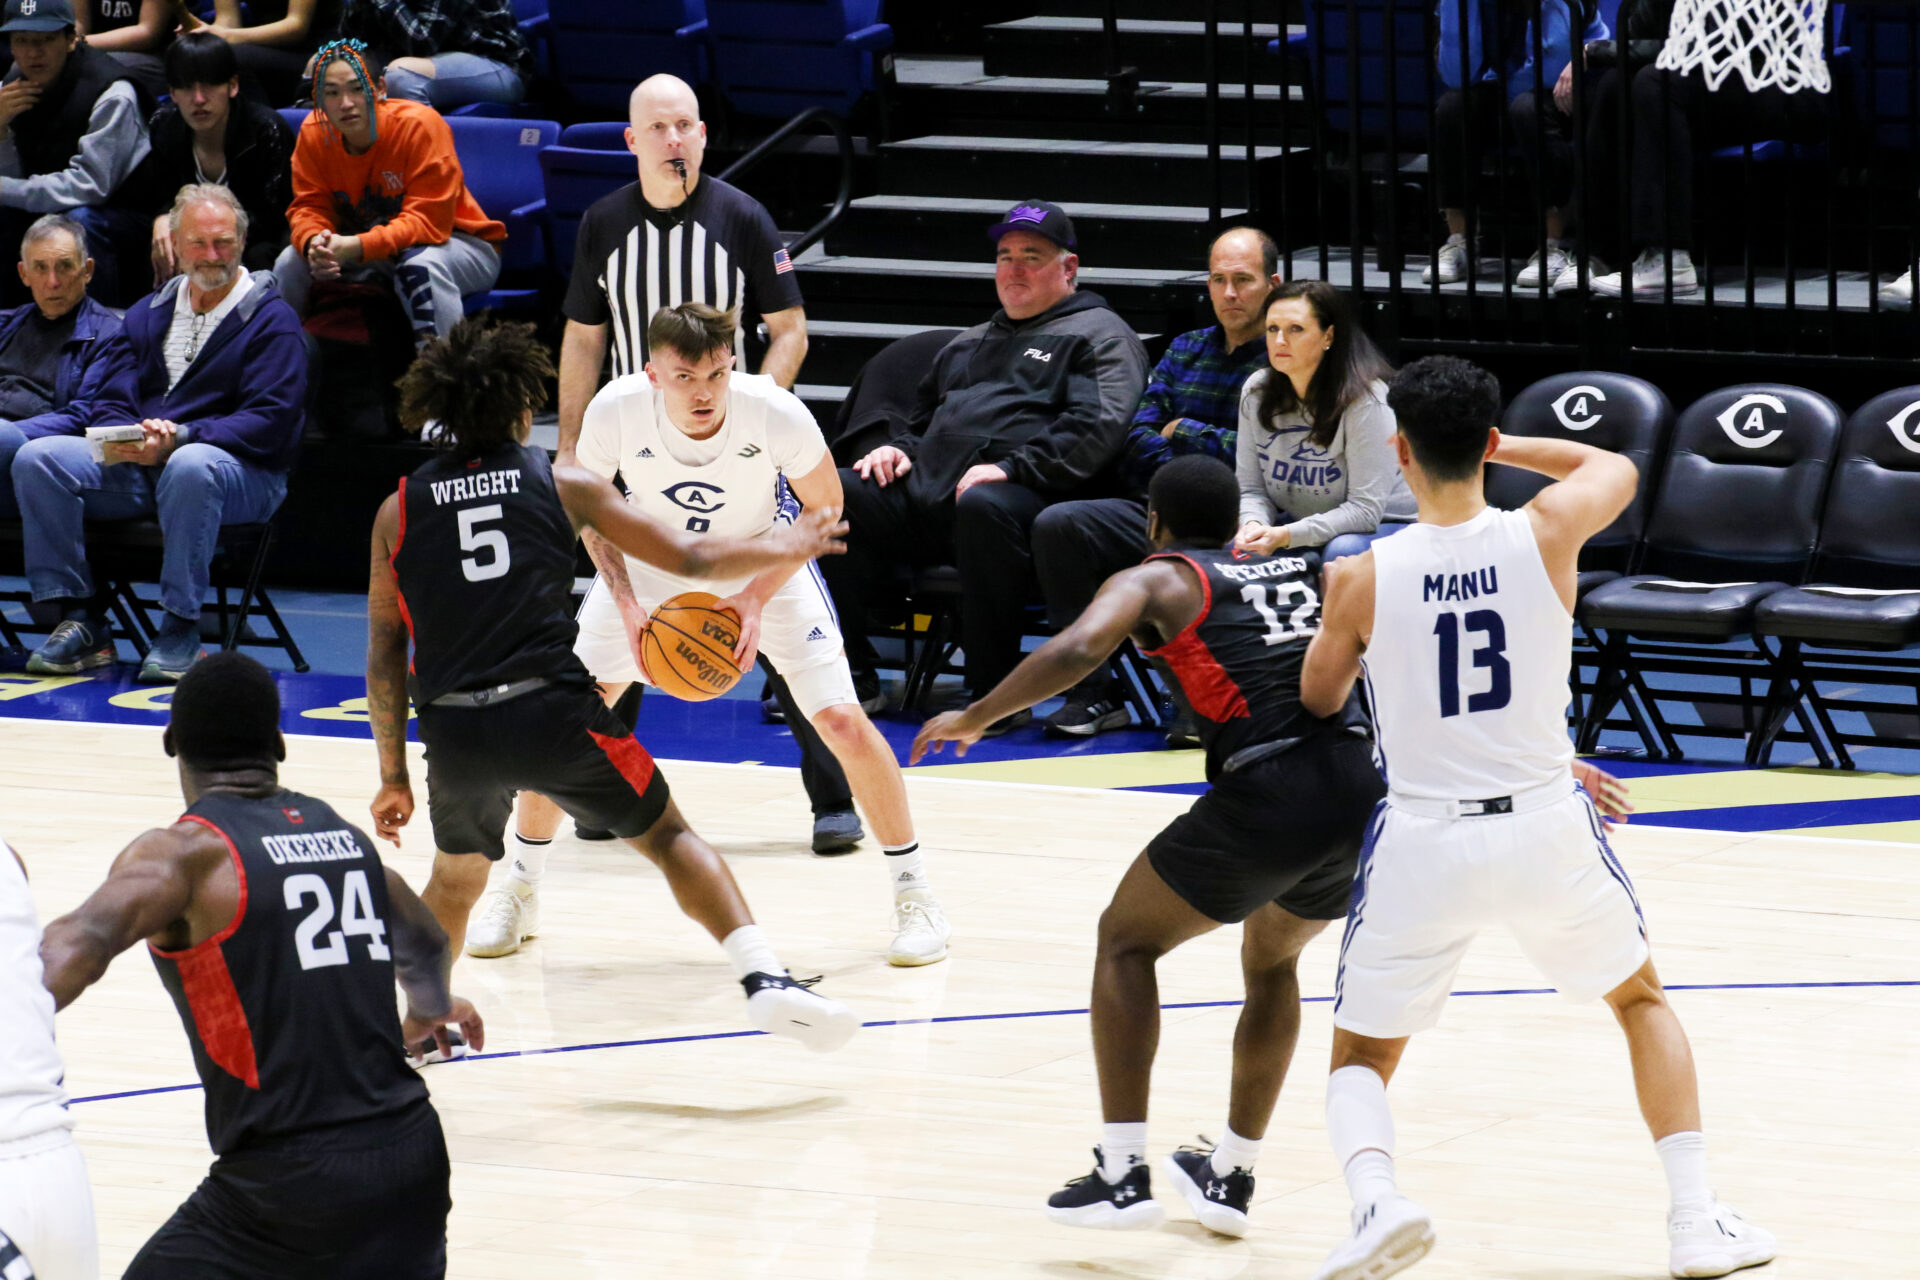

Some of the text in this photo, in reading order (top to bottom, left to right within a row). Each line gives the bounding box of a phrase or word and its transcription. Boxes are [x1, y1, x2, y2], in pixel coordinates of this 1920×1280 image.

[1023, 348, 1052, 362] FILA
[430, 468, 521, 506] WRIGHT
[1271, 460, 1342, 487] DAVIS
[457, 503, 511, 582] 5
[1423, 565, 1498, 602] MANU
[1240, 580, 1322, 646] 12
[701, 619, 737, 652] CAA
[675, 639, 733, 690] Wilson
[1433, 609, 1511, 718] 13
[261, 829, 364, 865] OKEREKE
[283, 869, 392, 971] 24
